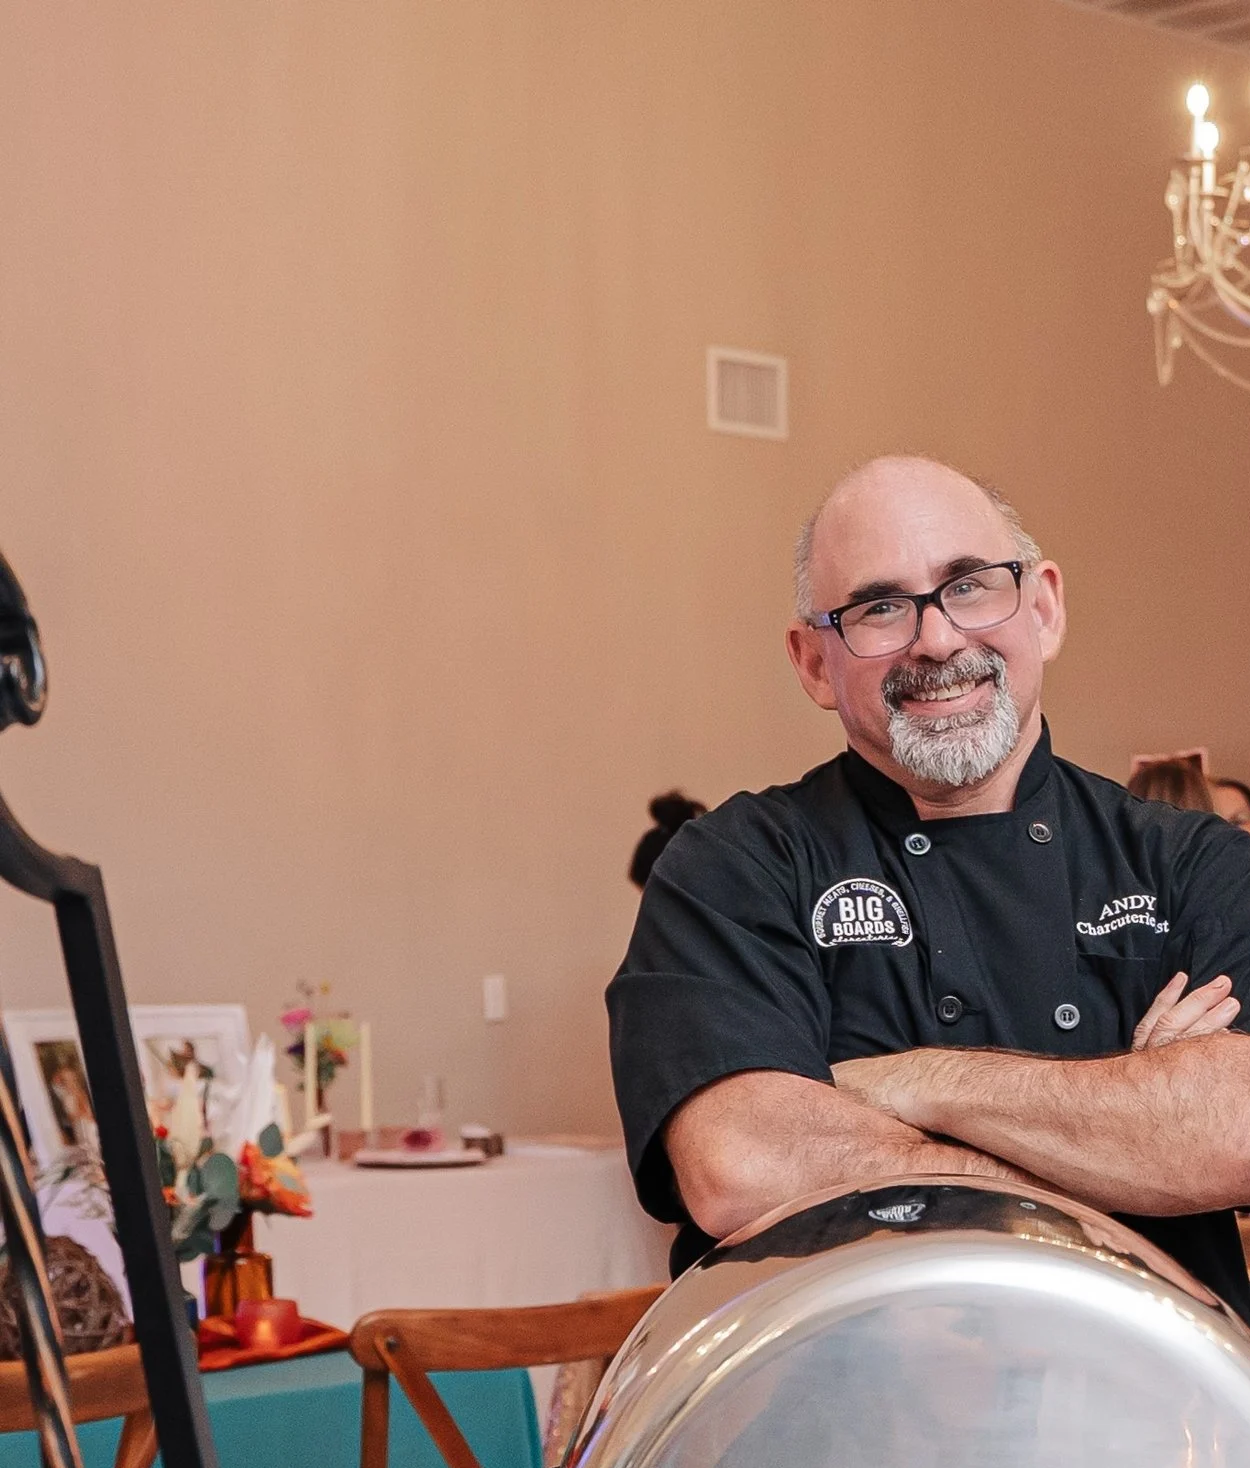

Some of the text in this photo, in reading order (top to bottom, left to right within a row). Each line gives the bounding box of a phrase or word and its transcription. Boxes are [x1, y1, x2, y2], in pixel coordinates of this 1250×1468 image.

[838, 896, 884, 922] BIG
[1099, 894, 1157, 921] ANDY
[832, 920, 896, 937] BOARDS
